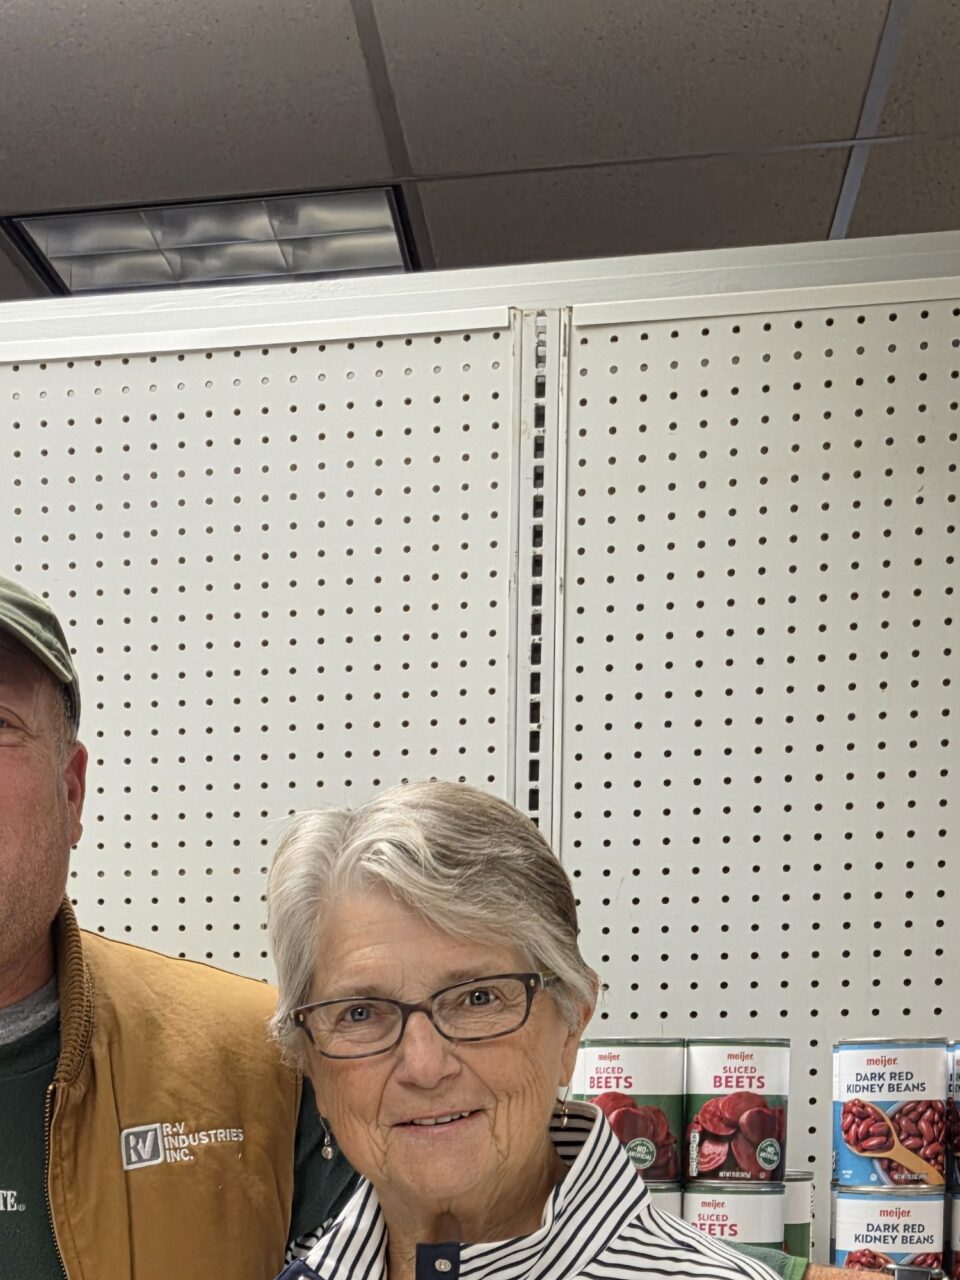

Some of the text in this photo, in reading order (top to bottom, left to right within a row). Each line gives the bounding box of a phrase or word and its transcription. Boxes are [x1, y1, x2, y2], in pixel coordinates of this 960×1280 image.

[598, 1053, 620, 1062] meijer
[727, 1051, 754, 1062] meijer
[866, 1055, 898, 1067] meijer
[722, 1066, 757, 1074] SLICED
[713, 1075, 765, 1089] BEETS
[855, 1071, 914, 1082] DARK RED
[589, 1076, 633, 1089] BEETS
[846, 1082, 926, 1094] KIDNEY BEANS
[163, 1128, 244, 1149] INDUSTRIES
[166, 1148, 194, 1163] INC.
[701, 1200, 725, 1209] meijer
[698, 1213, 728, 1221] SLICED
[880, 1208, 911, 1219] meijer
[866, 1223, 925, 1233] DARK RED
[854, 1234, 934, 1244] KIDNEY BEANS
